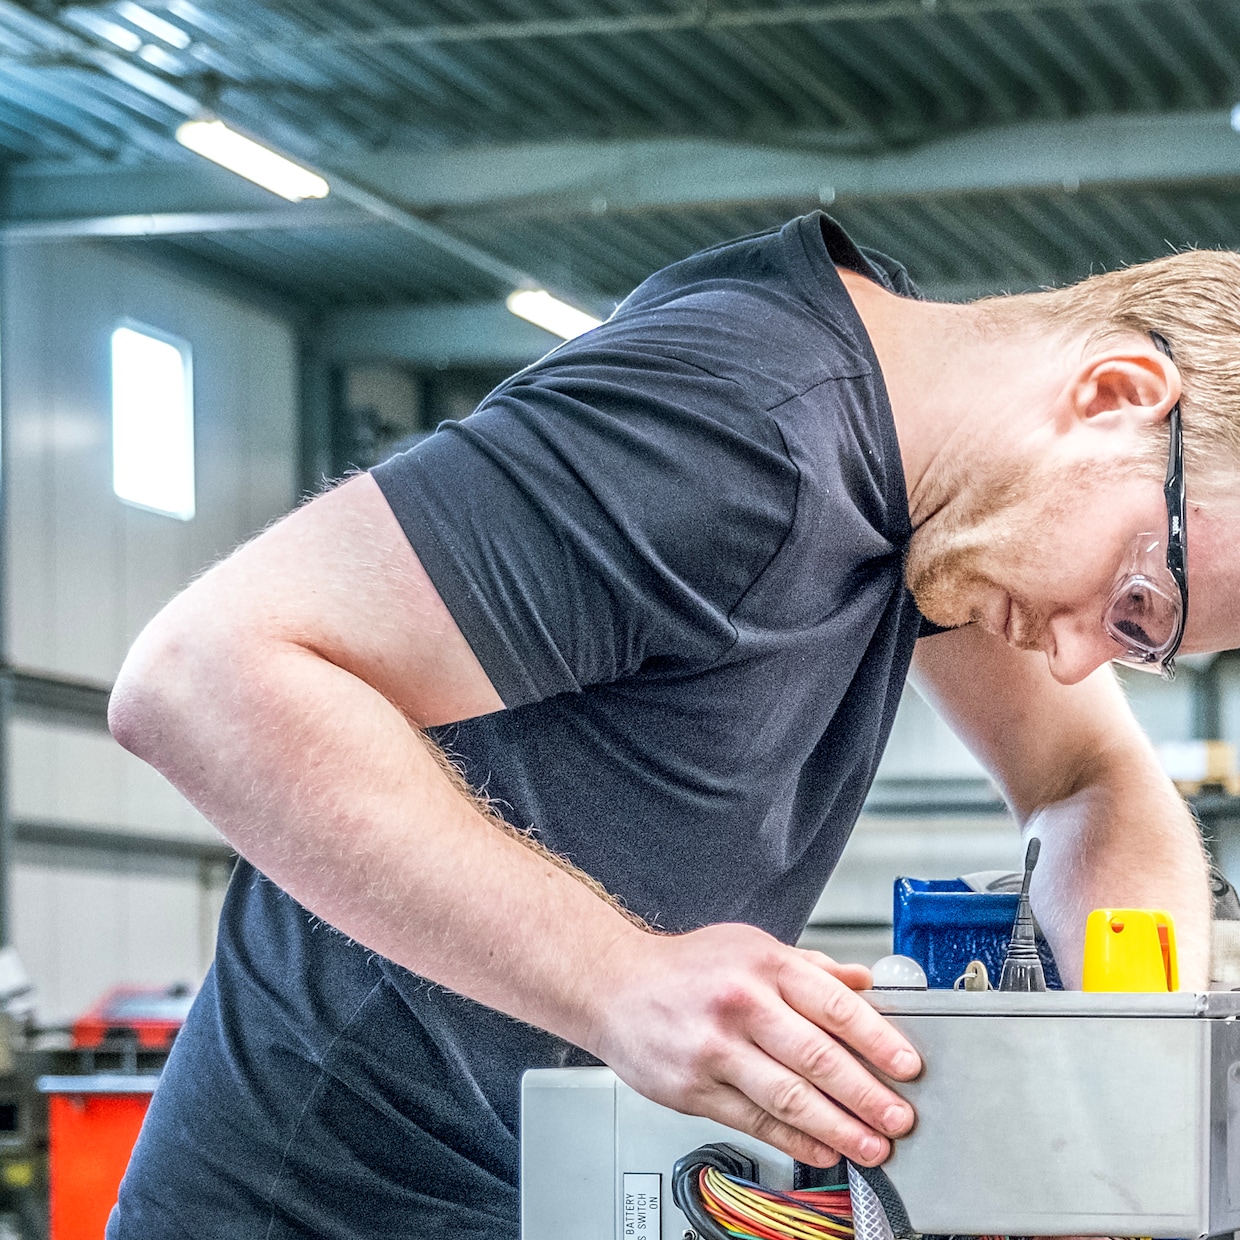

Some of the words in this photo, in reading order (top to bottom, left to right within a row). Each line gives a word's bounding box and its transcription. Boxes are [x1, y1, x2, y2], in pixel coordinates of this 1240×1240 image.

[626, 1194, 634, 1234] BATTERY
[638, 1194, 646, 1229] SWITCH
[649, 1197, 658, 1209] ON
